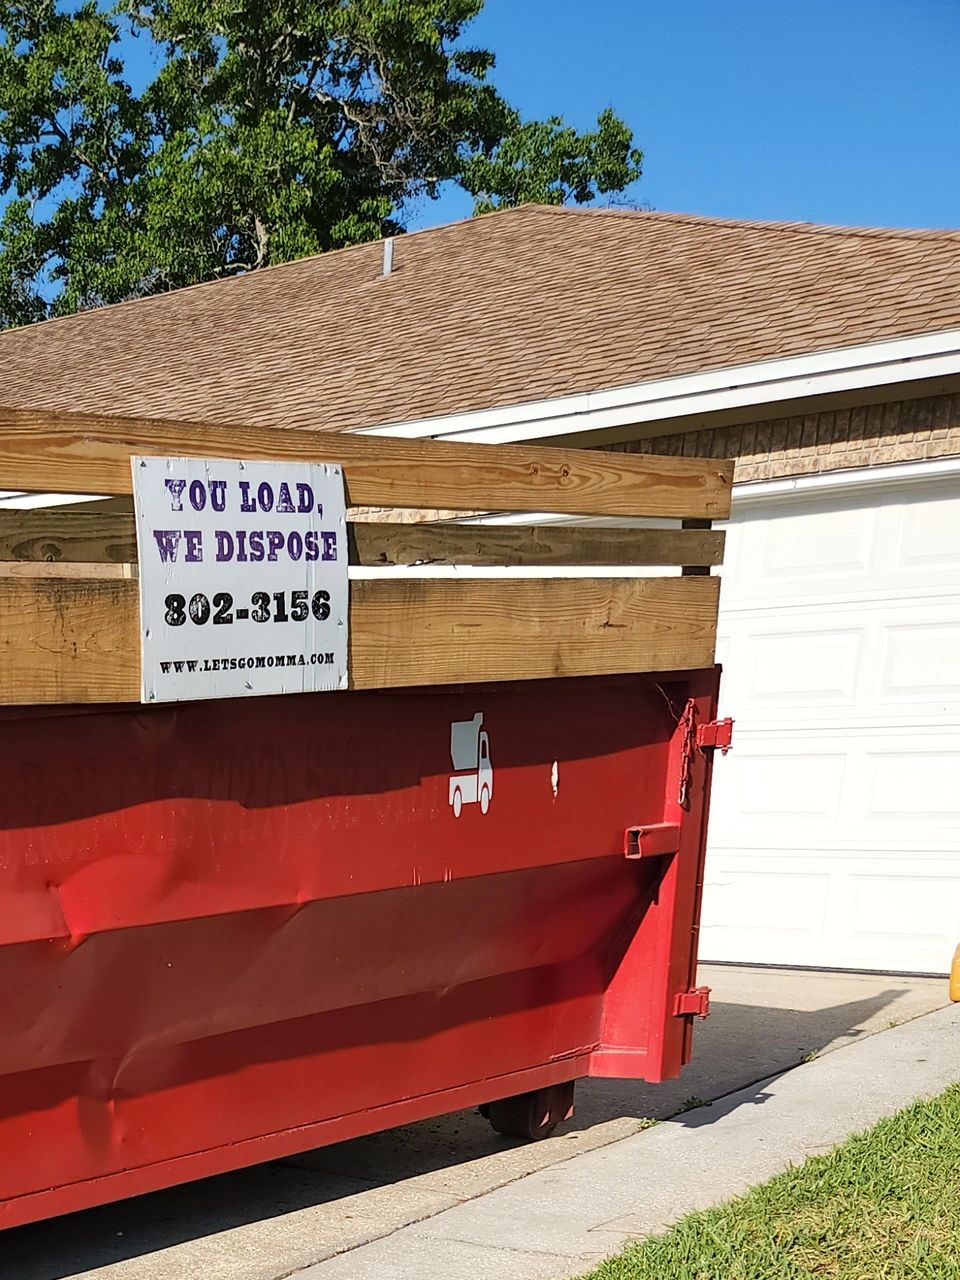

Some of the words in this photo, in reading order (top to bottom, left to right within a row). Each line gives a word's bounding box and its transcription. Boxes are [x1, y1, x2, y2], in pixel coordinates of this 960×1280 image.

[165, 479, 227, 512] YOU
[239, 481, 323, 520] LOAD,
[153, 530, 204, 563] WE
[215, 530, 338, 562] DISPOSE
[164, 590, 331, 626] 802-3156
[160, 653, 335, 674] WWW.LETSGOMOMMA.COM
